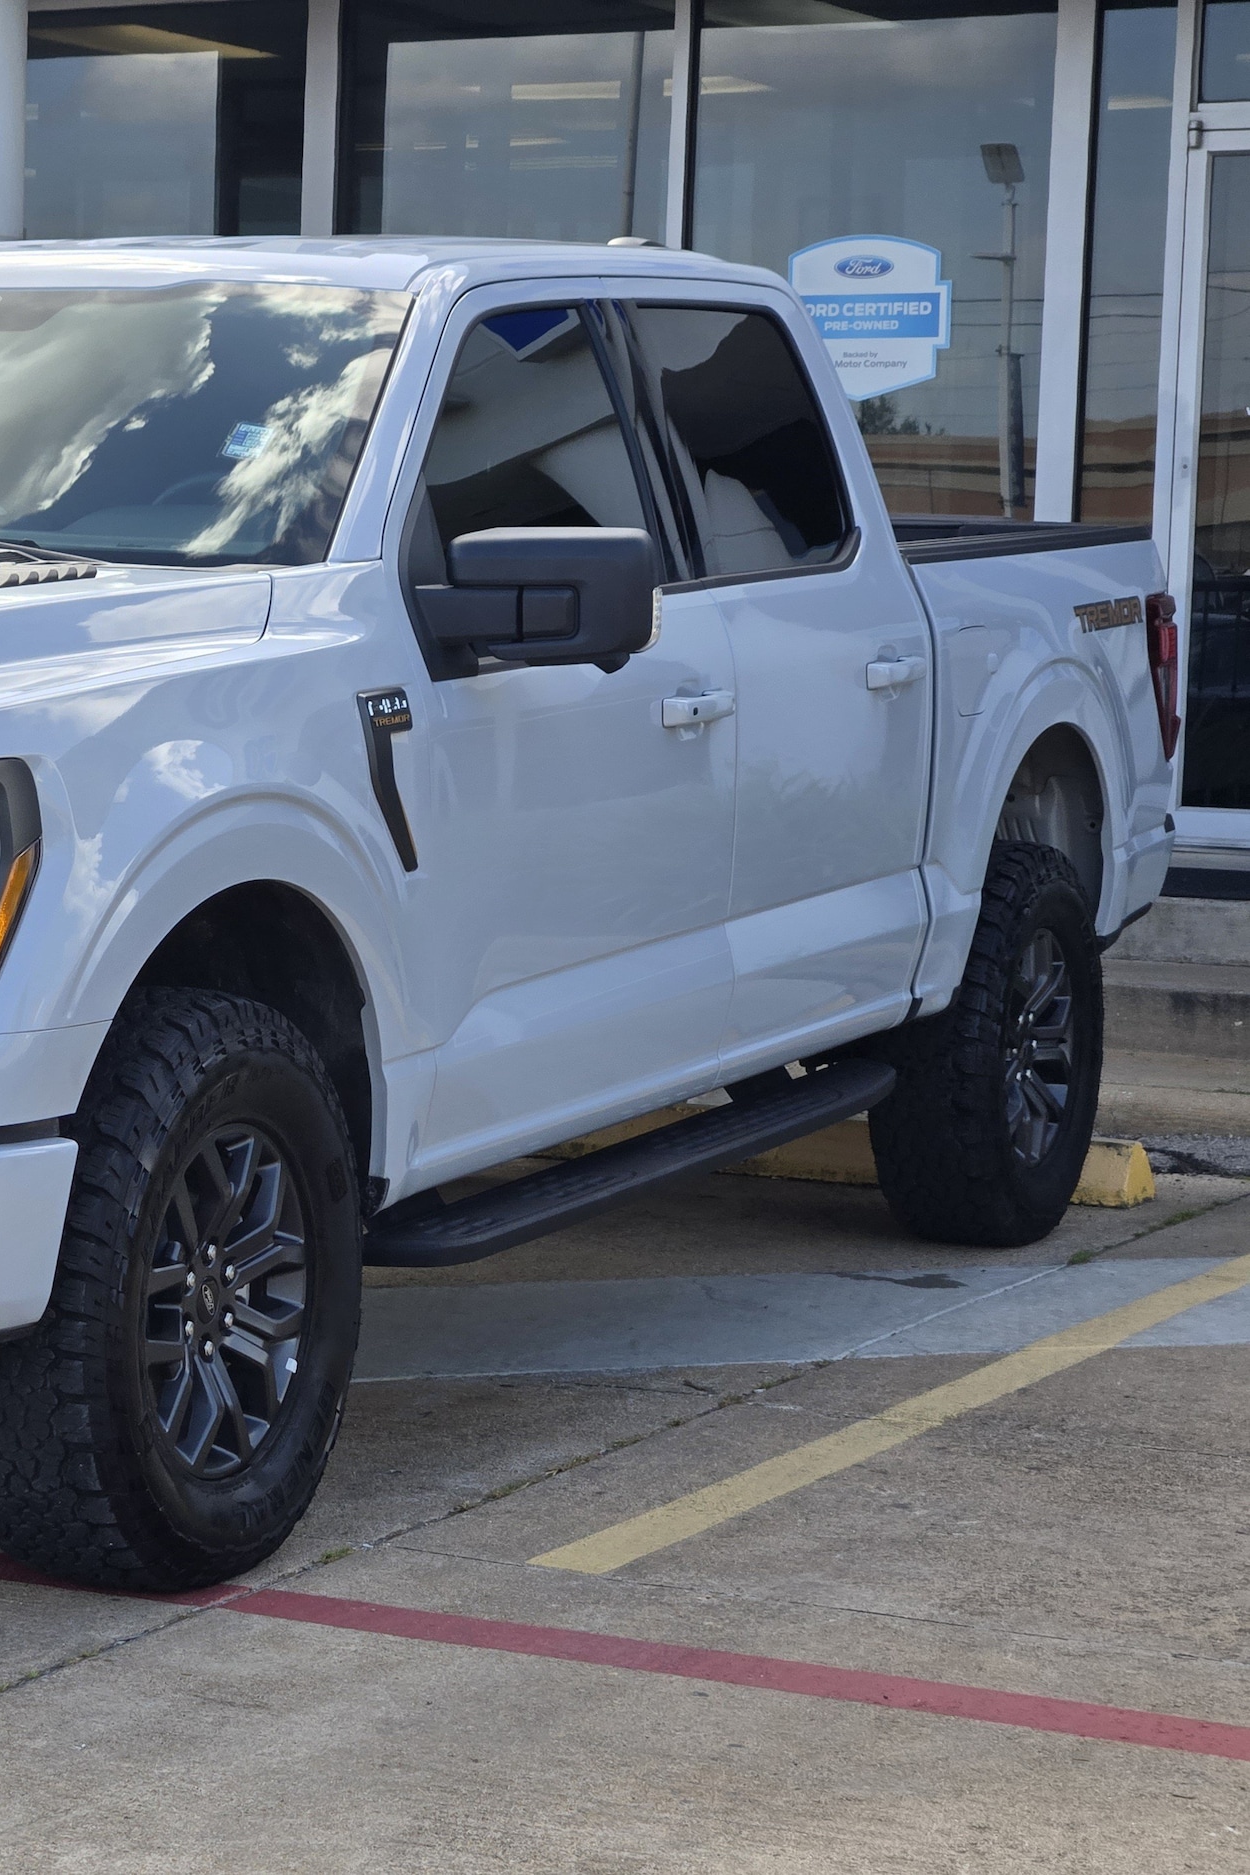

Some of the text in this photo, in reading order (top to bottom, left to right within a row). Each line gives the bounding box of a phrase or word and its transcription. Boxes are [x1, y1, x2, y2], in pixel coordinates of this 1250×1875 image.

[845, 258, 882, 275] Ford
[805, 301, 932, 317] ORD CERTIFIED
[824, 320, 899, 332] PRE-OWNED
[869, 351, 878, 359] by
[834, 360, 908, 369] Motor Company
[1073, 596, 1144, 633] TREMOR
[373, 714, 410, 727] TREMOR
